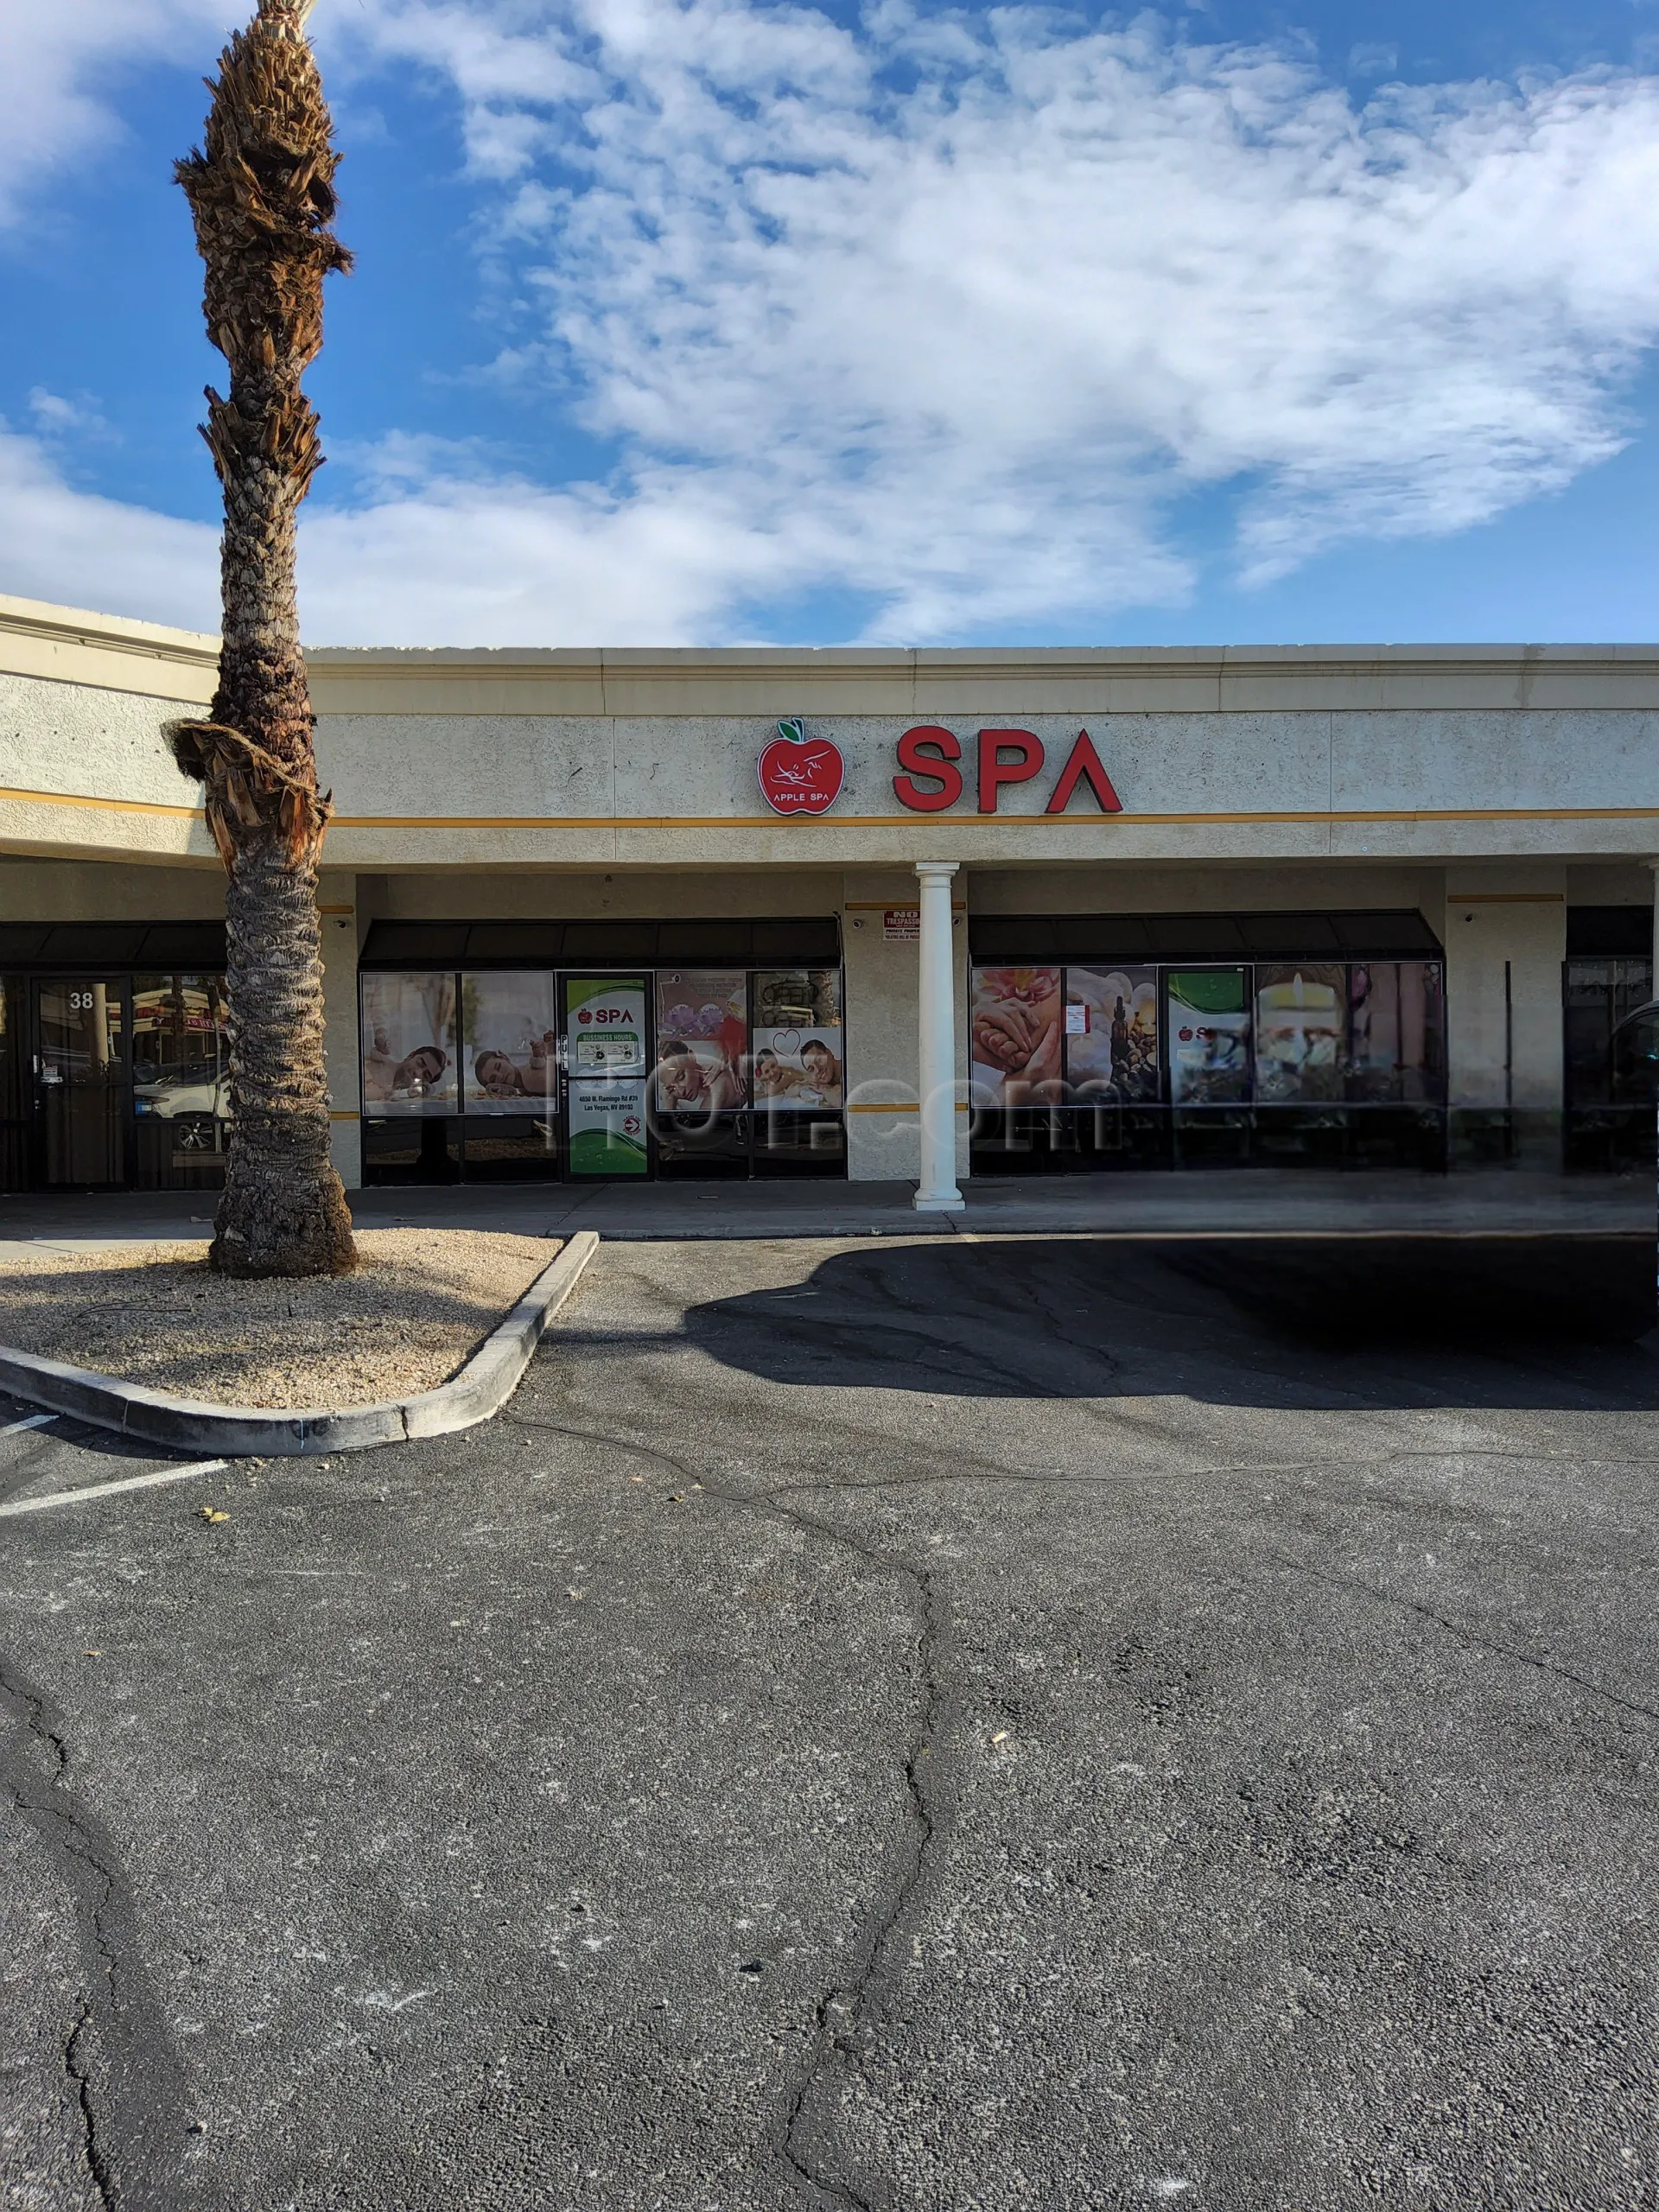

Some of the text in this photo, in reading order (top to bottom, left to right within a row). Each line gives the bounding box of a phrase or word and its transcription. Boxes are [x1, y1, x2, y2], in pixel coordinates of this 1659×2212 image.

[893, 725, 1123, 814] SPA
[773, 793, 830, 802] APPLE SPA
[69, 992, 93, 1009] 38
[596, 1008, 633, 1023] SPA
